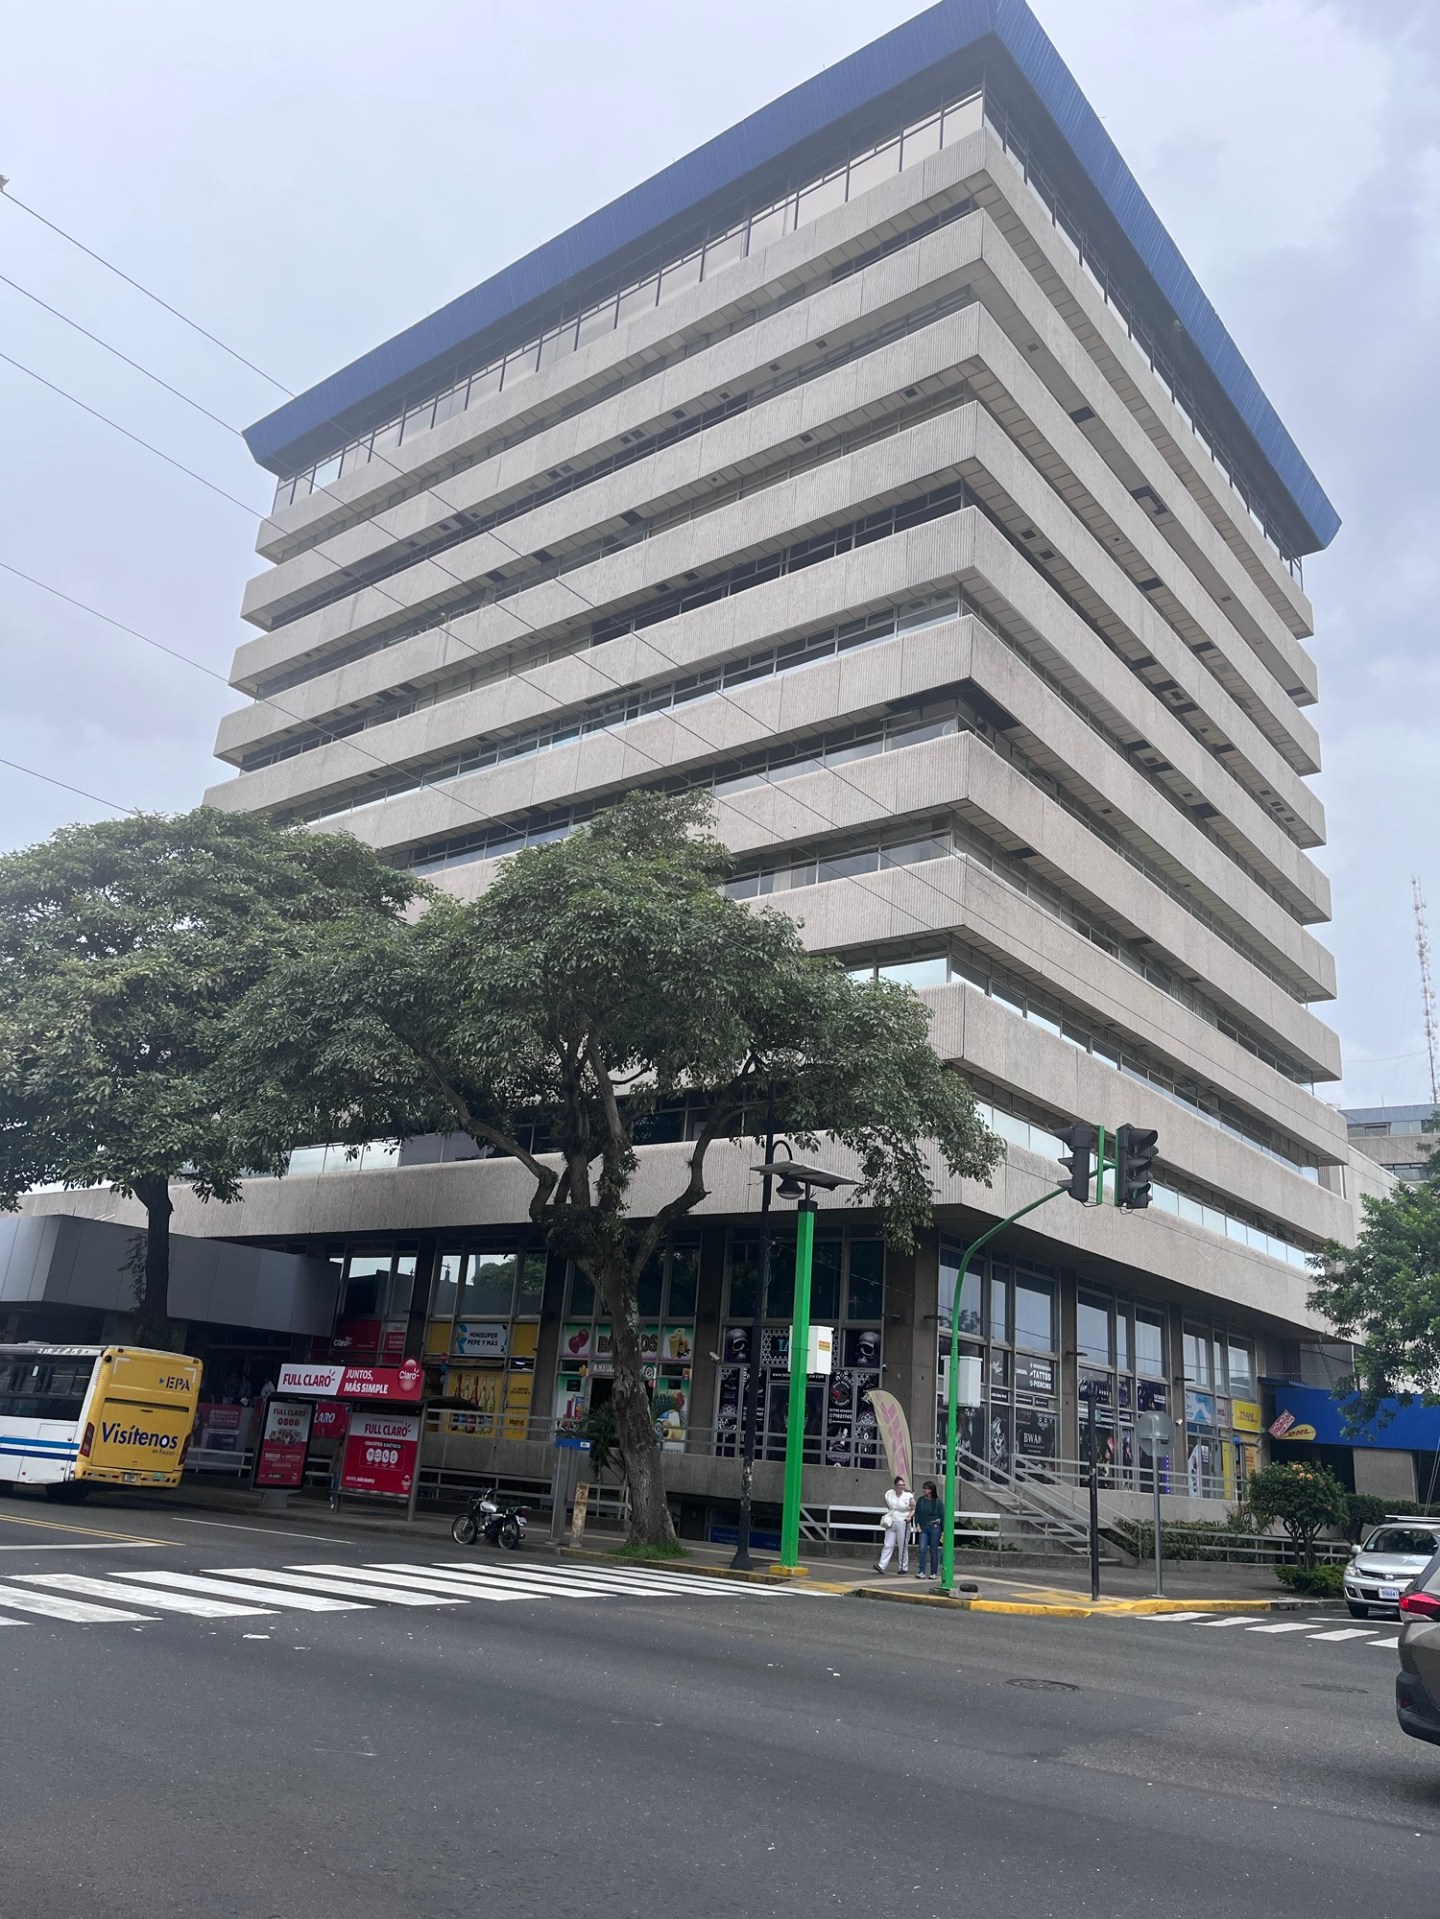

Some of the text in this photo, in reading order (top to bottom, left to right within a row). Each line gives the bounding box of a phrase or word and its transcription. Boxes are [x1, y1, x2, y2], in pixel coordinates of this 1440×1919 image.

[282, 1373, 331, 1387] FULL CLARO
[399, 1369, 418, 1380] Claro
[1033, 1370, 1052, 1382] TATTOO
[166, 1376, 190, 1391] EPA
[344, 1381, 388, 1394] MÁS SIMPLE
[1034, 1381, 1052, 1390] PIERCING
[288, 1409, 306, 1417] CLARO
[314, 1412, 335, 1423] LARO
[102, 1422, 178, 1449] Visítenos
[364, 1424, 408, 1437] FULL CLARO
[1287, 1428, 1311, 1437] DHL
